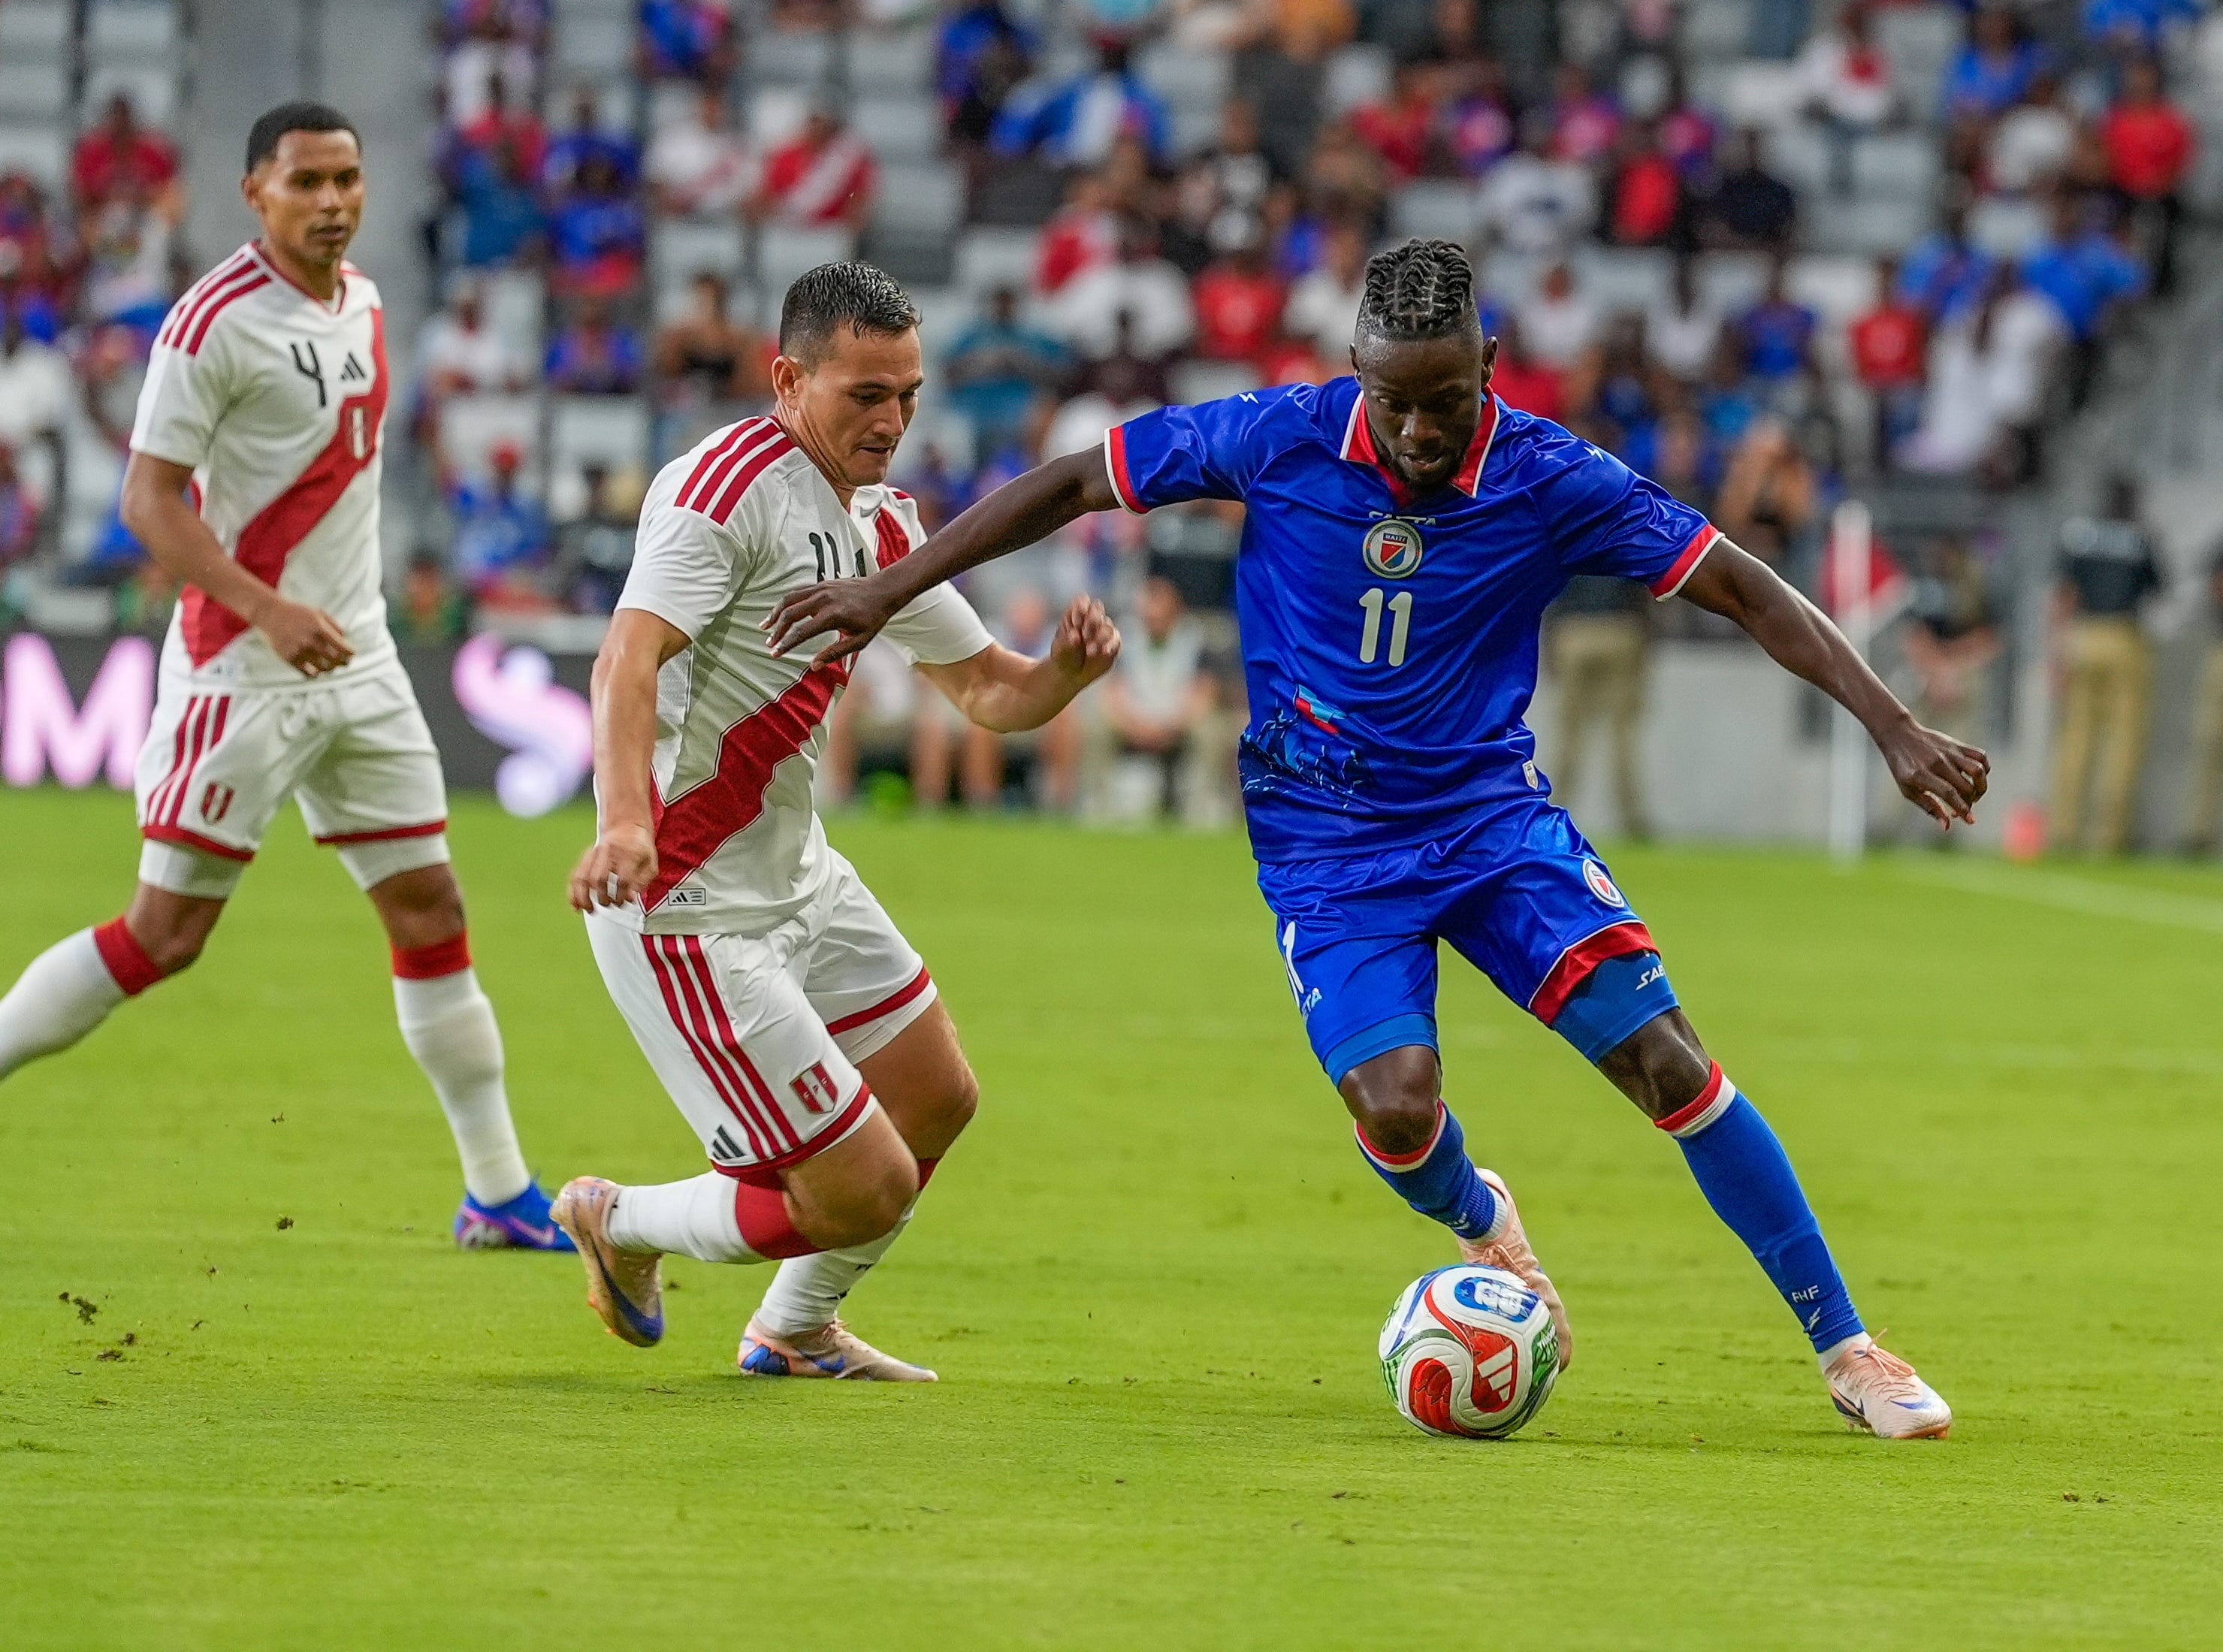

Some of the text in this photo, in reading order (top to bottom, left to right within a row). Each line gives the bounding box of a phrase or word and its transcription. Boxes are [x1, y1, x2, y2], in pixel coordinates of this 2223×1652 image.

[290, 340, 327, 408] 4
[1358, 587, 1412, 667] 11
[2, 631, 154, 790] M
